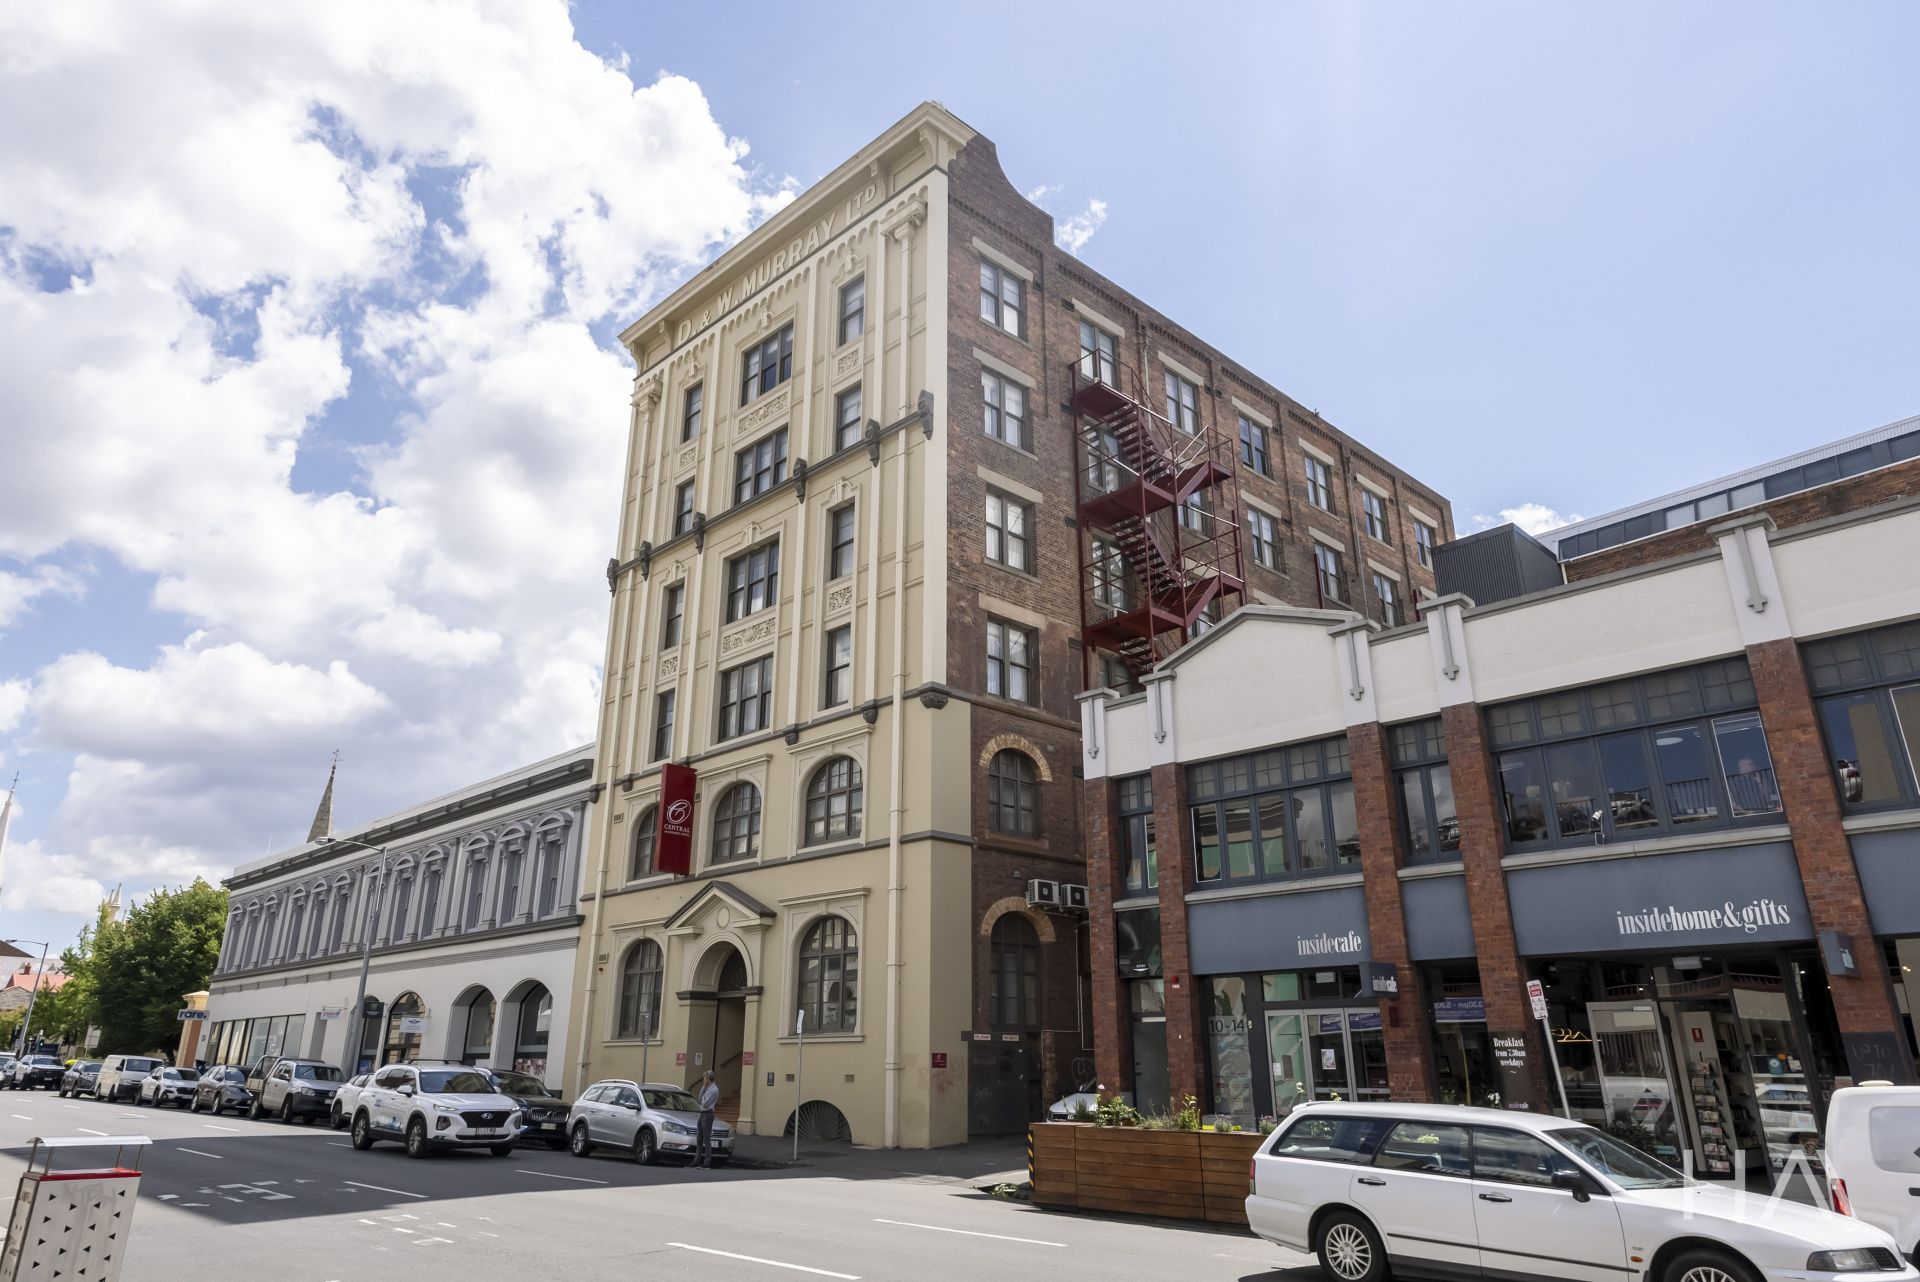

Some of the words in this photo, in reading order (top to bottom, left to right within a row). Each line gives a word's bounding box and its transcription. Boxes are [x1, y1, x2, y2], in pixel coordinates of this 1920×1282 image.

[702, 310, 711, 329] &
[743, 213, 836, 298] MURRAY
[847, 185, 877, 222] LTD
[664, 823, 690, 832] CENTRAL
[1616, 898, 1791, 935] insidehome&gifts
[1297, 930, 1362, 956] insidecafe
[1209, 1019, 1244, 1032] 10-14
[1493, 1037, 1524, 1048] Breakfast
[1500, 1058, 1524, 1068] weekdays
